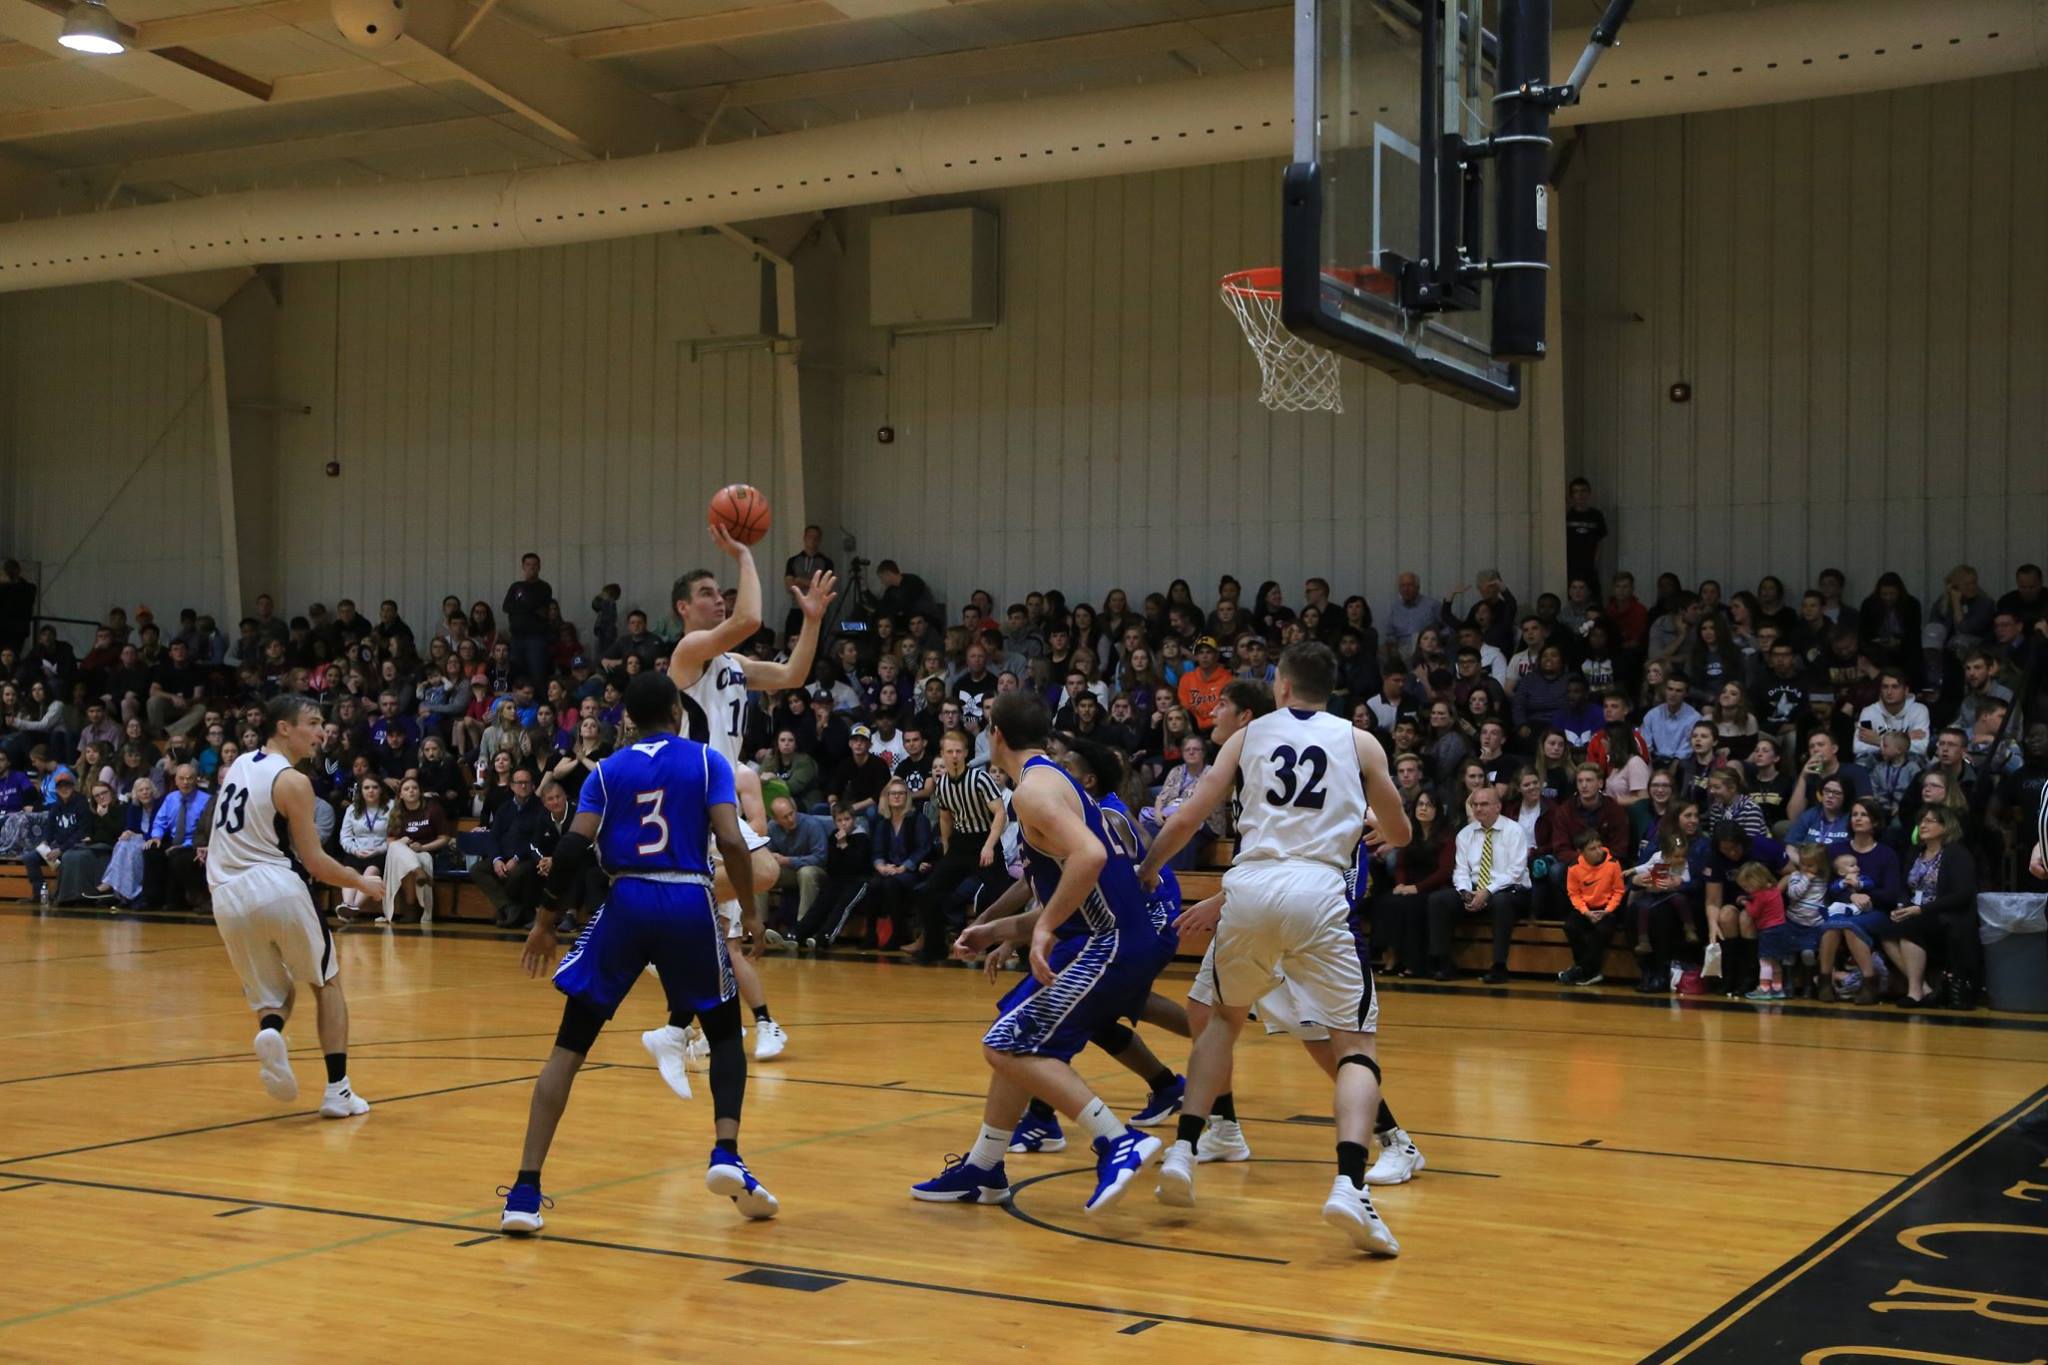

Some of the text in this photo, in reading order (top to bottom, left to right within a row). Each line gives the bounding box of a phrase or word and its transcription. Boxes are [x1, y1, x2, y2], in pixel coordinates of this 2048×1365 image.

[216, 783, 249, 834] 33
[1266, 744, 1328, 810] 32
[636, 789, 670, 857] 3
